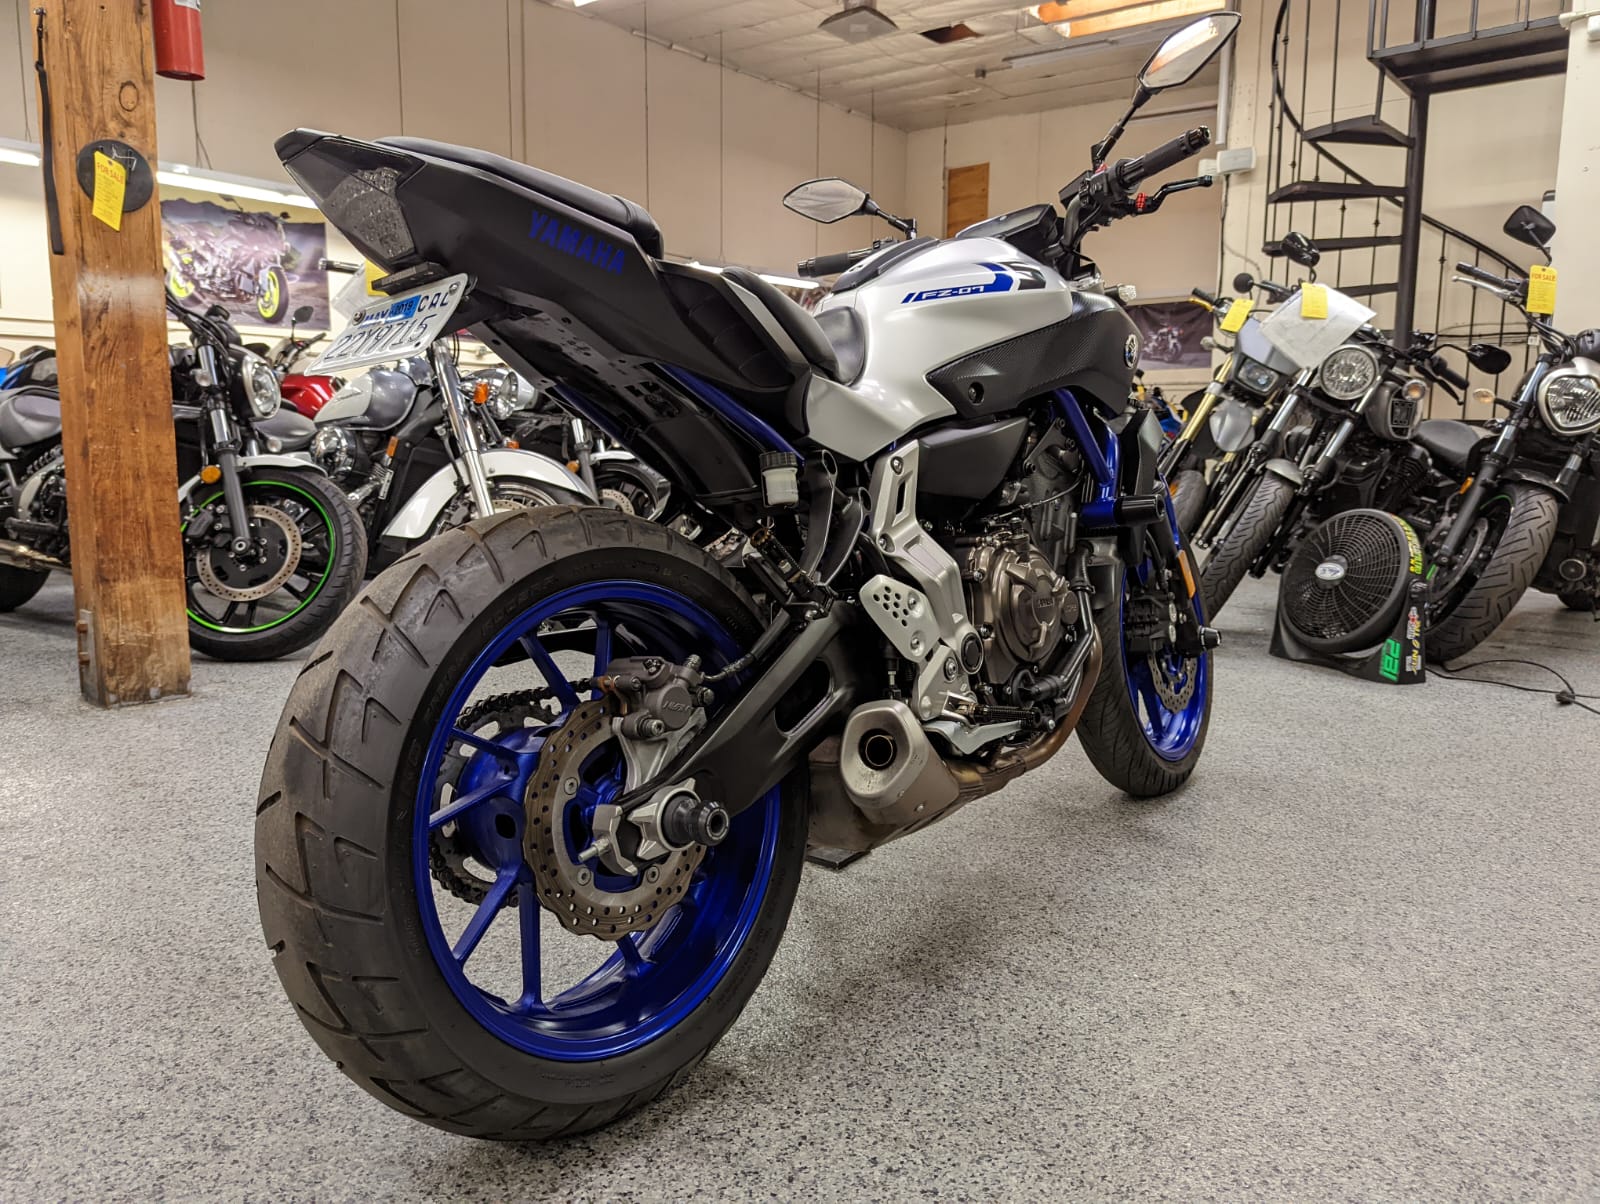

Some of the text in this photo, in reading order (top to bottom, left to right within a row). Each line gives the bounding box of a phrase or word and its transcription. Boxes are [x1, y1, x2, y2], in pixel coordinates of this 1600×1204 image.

[528, 210, 625, 276] YAMAHA
[418, 291, 449, 312] CAL
[921, 285, 985, 300] FZ-07
[324, 313, 438, 360] 22Y9715
